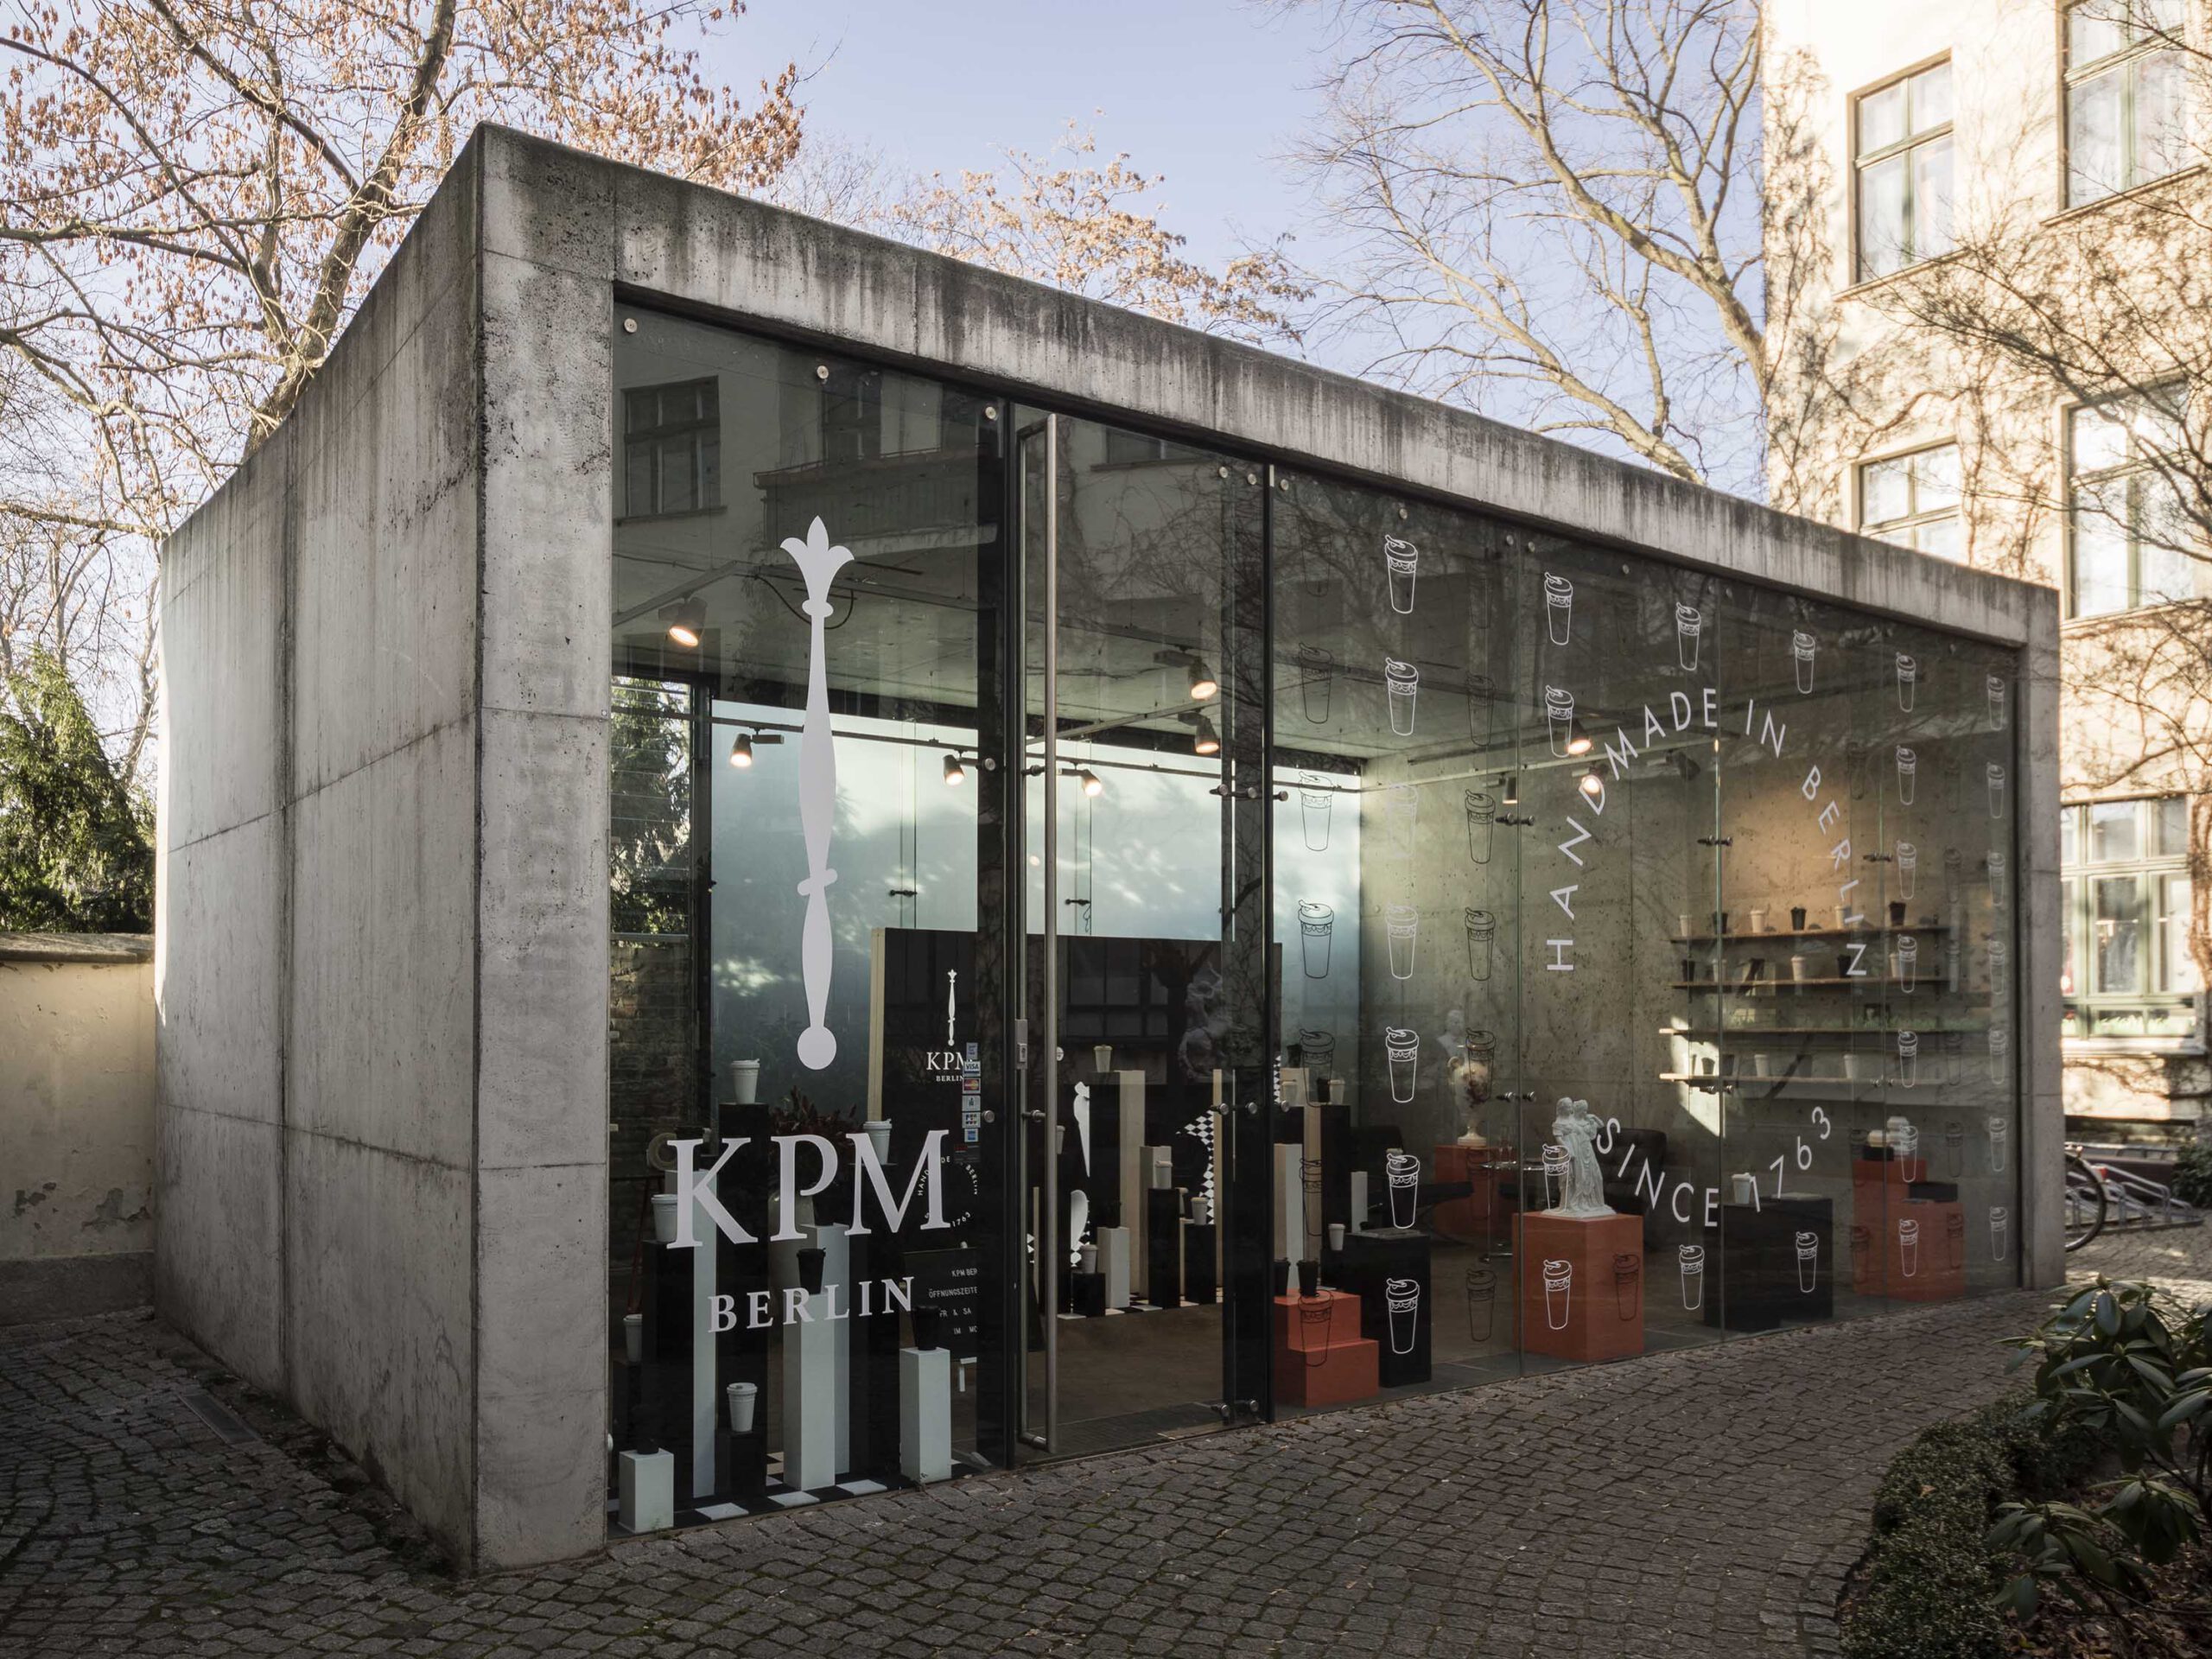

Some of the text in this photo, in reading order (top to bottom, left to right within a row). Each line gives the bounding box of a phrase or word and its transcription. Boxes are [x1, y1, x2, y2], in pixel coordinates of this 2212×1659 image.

[1547, 688, 1867, 976] HANDMADE IN BERLIN
[666, 1128, 950, 1249] KPM
[1597, 1106, 1831, 1228] SINCE 1763
[707, 1275, 916, 1334] BERLIN
[951, 1268, 966, 1277] KPM
